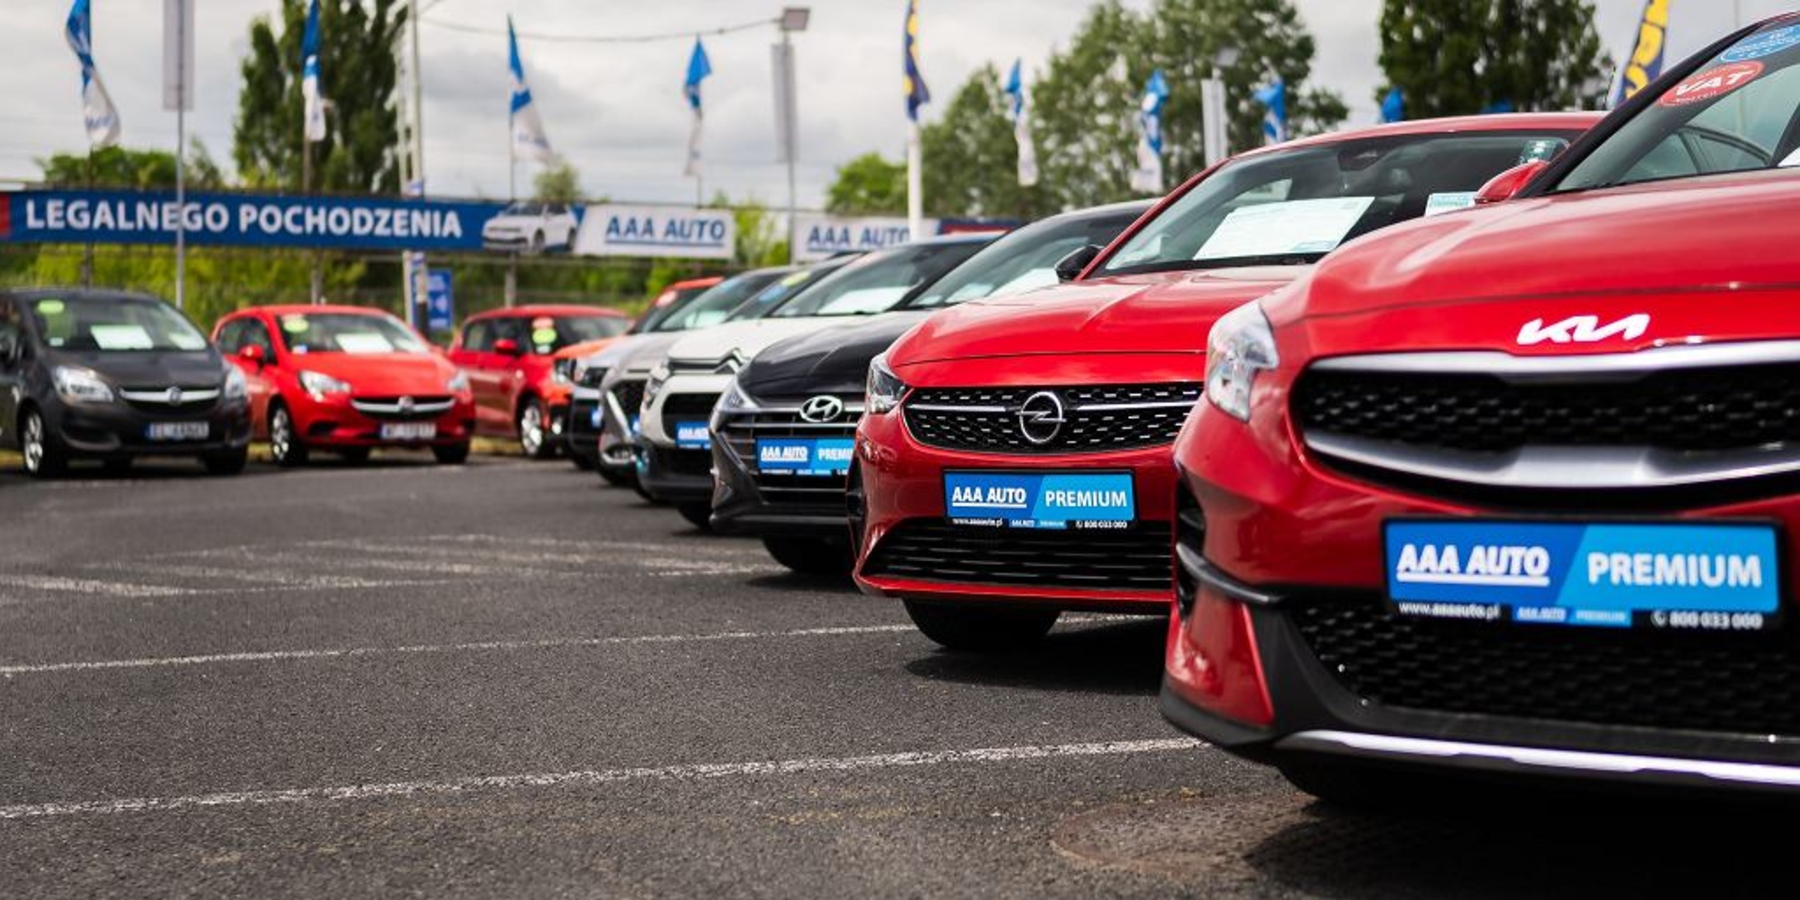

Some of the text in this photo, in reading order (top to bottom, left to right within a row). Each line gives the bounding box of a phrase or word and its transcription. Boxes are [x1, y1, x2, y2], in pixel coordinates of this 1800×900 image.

[1676, 69, 1755, 95] VAT
[26, 199, 462, 239] LEGALNEGO POCHODZENIA
[606, 216, 725, 240] AAA AUTO
[807, 225, 850, 246] AAA
[1516, 313, 1650, 345] KIA
[760, 446, 807, 460] AAA AUTO
[818, 447, 853, 461] PREMI
[952, 486, 1026, 504] AAA AUTO
[1045, 491, 1127, 508] PREMIUM
[1396, 544, 1549, 576] AAA AUTO
[1587, 552, 1762, 588] PREMIUM
[1399, 601, 1500, 620] www.aaaauto.pl
[1517, 607, 1567, 619] AAA AUTO
[1669, 611, 1763, 629] 800 033 000
